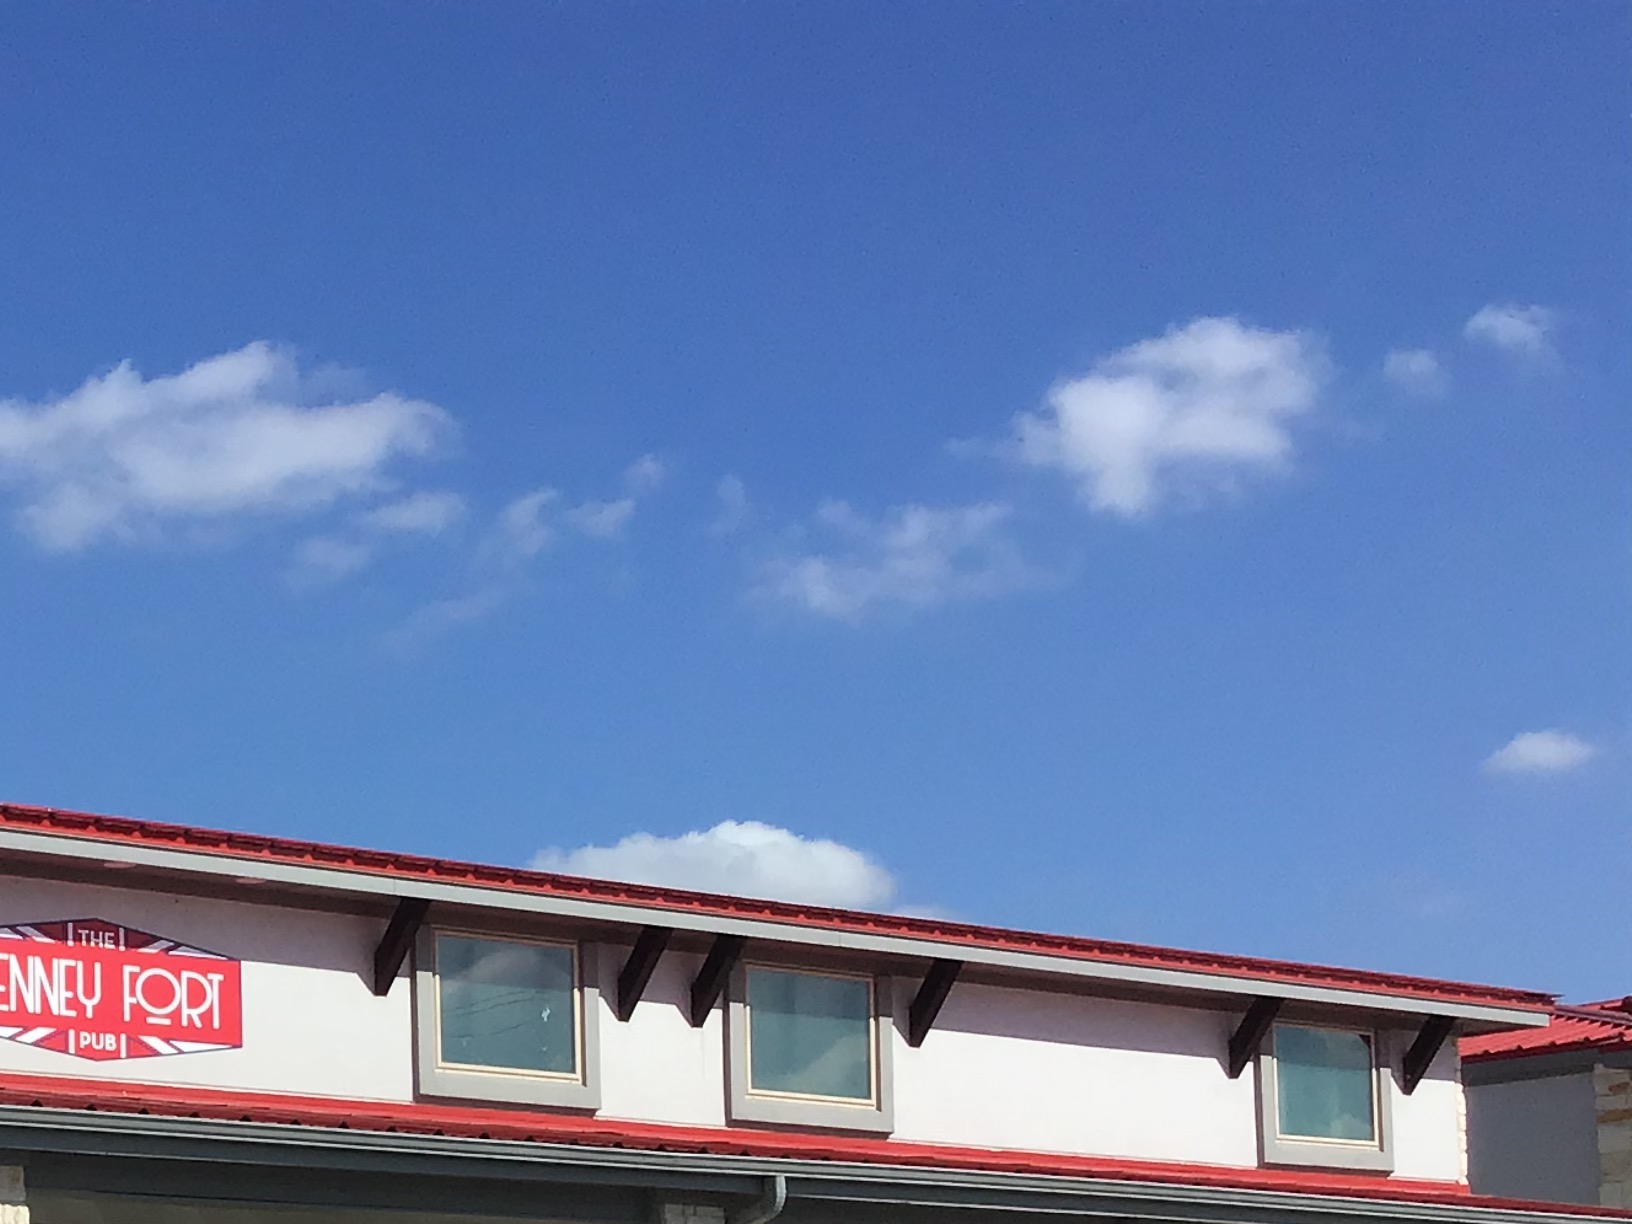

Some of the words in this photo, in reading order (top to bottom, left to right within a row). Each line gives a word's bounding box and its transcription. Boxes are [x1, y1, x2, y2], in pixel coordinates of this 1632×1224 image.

[77, 928, 115, 949] THE
[122, 964, 224, 1030] FORT
[79, 1033, 117, 1051] PUB
